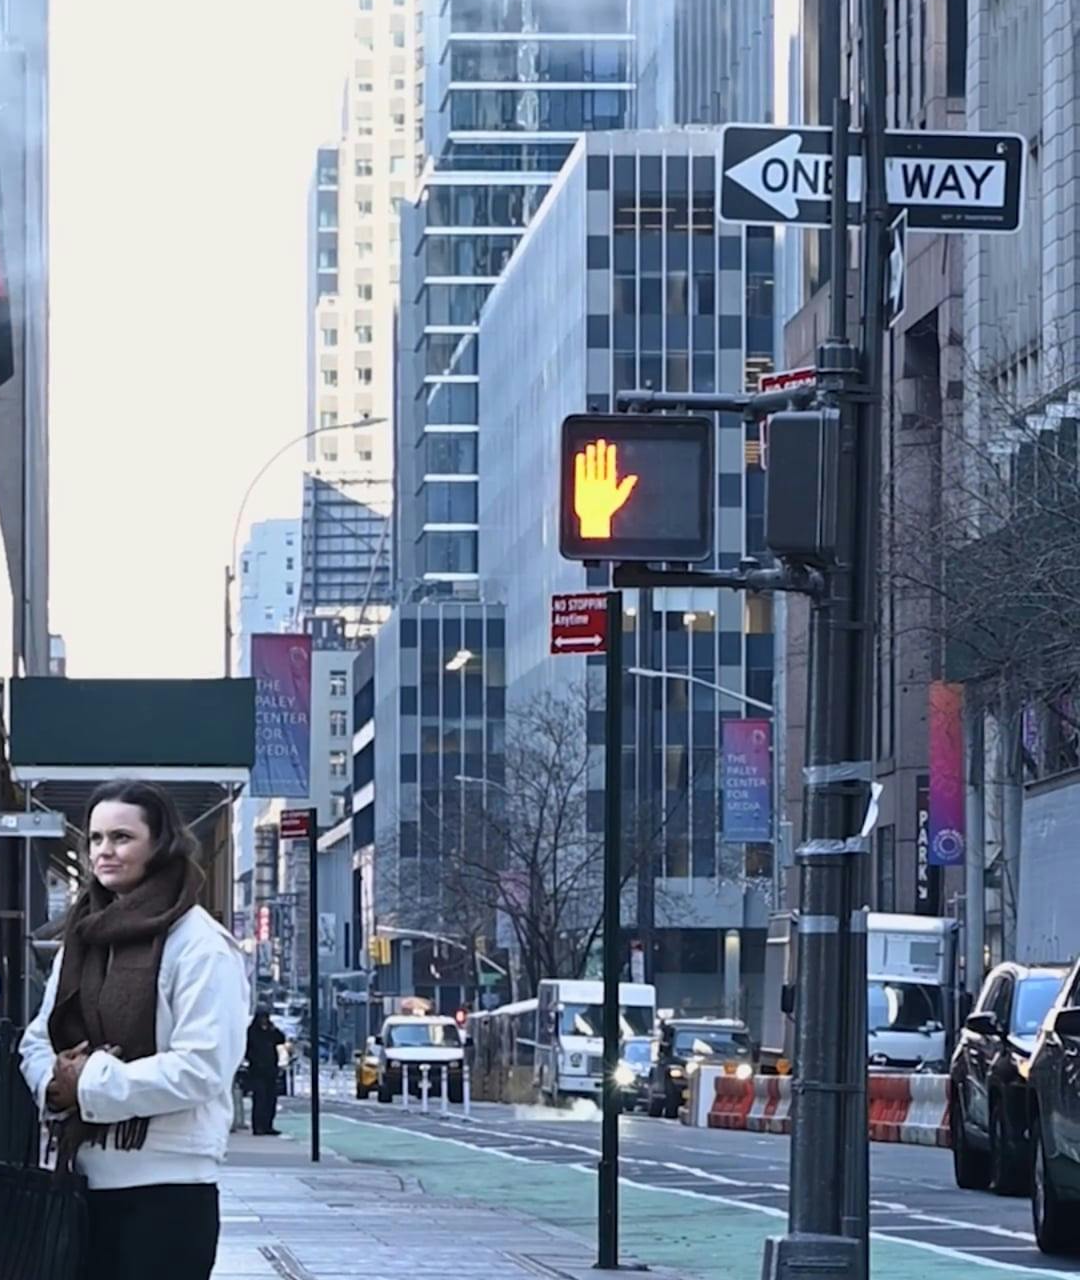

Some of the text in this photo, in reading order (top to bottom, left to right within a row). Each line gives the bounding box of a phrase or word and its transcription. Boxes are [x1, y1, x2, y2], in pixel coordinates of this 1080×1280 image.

[902, 164, 994, 200] WAY
[555, 600, 566, 611] NO
[256, 679, 281, 691] THE
[256, 696, 296, 707] PALEY
[256, 712, 307, 725] CENTER
[256, 728, 283, 740] FOR
[256, 744, 298, 756] MEDIA
[918, 810, 928, 880] PARK
